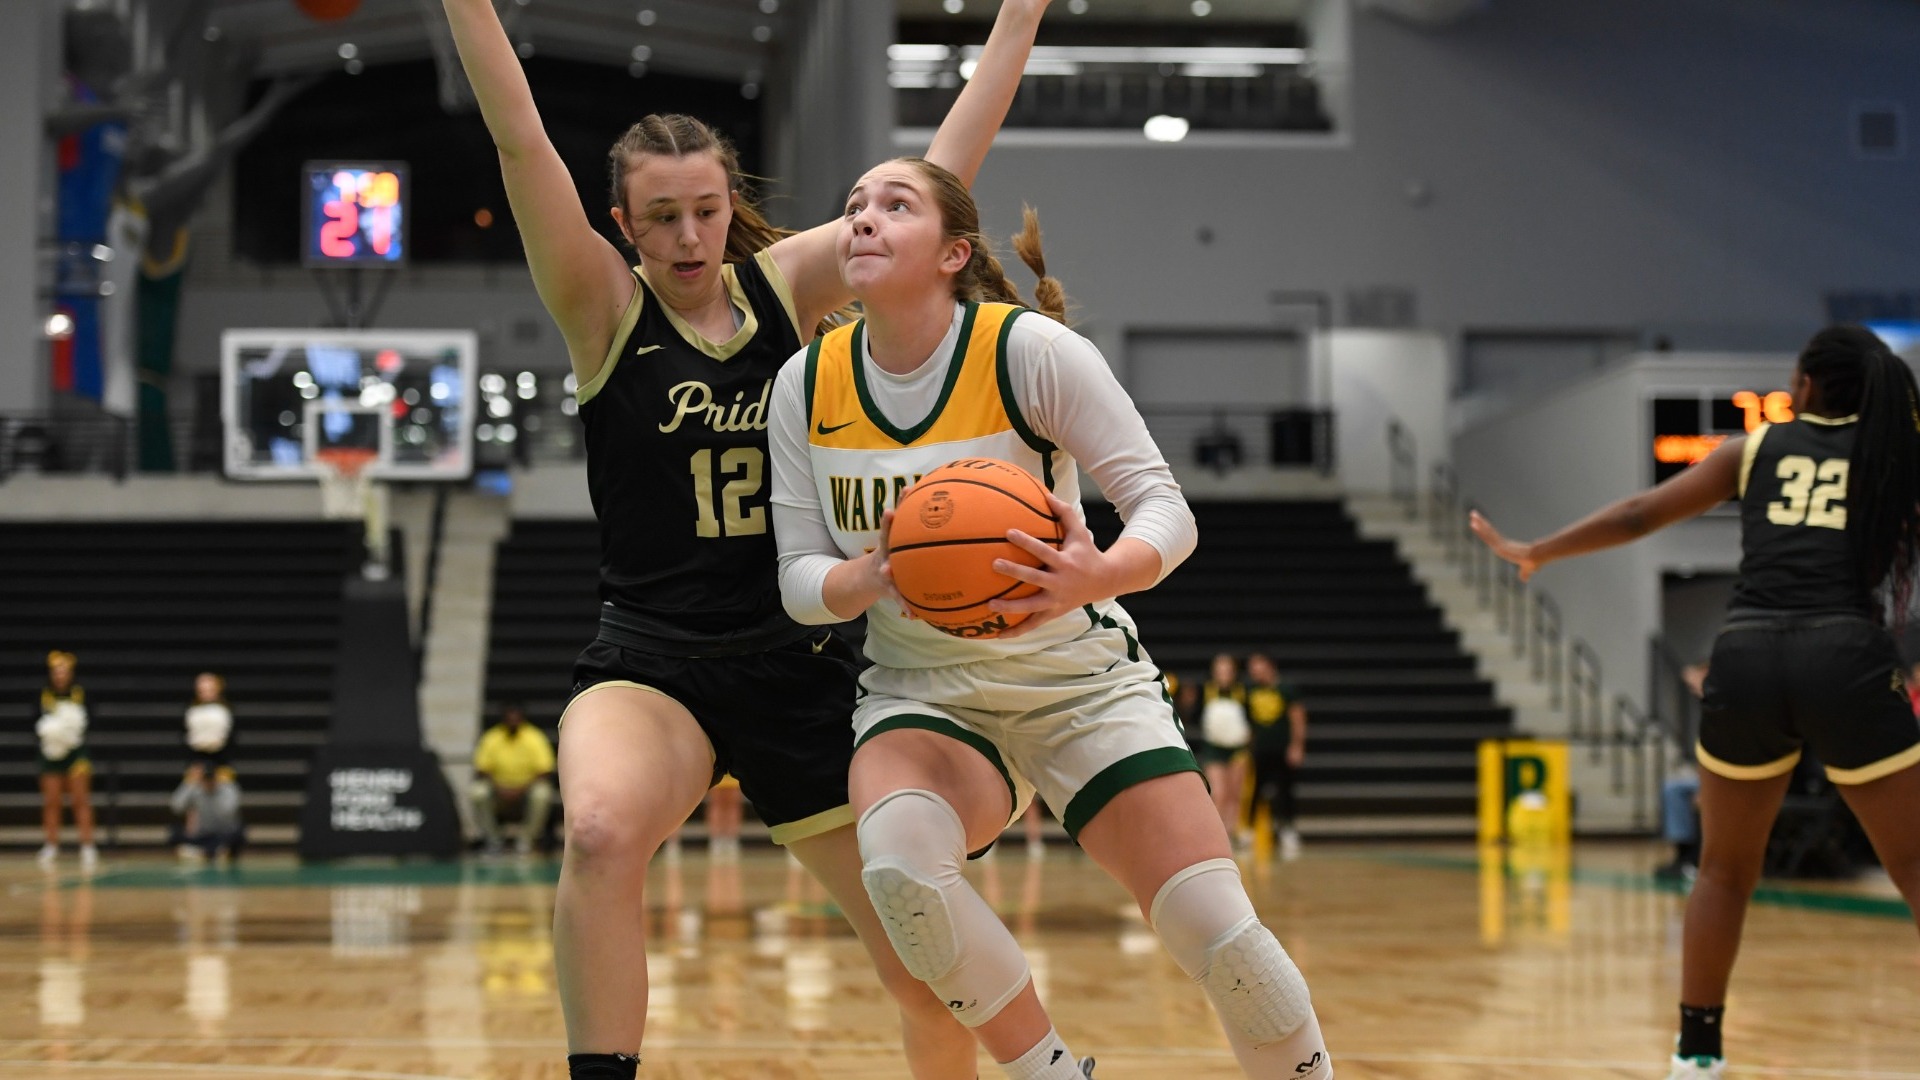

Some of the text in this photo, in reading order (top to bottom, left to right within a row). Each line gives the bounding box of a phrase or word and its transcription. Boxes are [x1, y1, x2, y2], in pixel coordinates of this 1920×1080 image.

[658, 378, 772, 434] Prid
[690, 447, 767, 538] 12
[1766, 455, 1849, 531] 32
